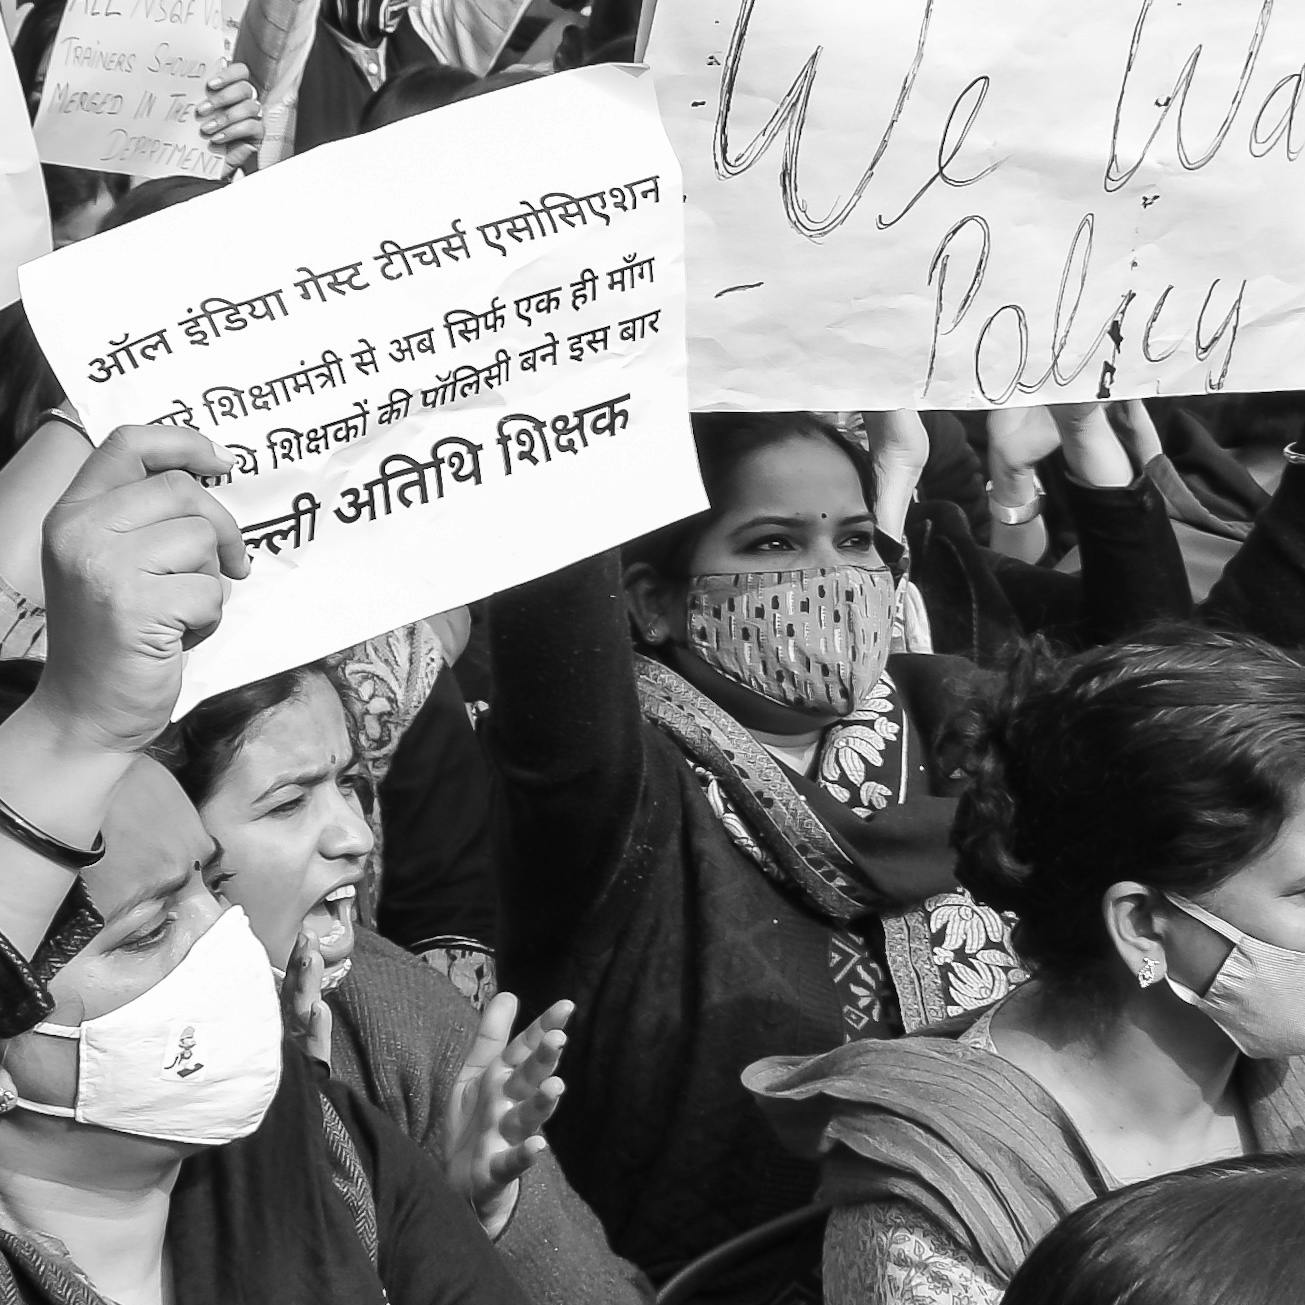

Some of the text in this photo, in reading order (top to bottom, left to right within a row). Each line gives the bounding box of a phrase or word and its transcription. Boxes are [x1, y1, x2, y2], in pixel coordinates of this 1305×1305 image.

[134, 89, 157, 120] IN
[88, 174, 661, 382] ऑल इंडिया गेस्ट टीचर्स एसोसिएशन
[202, 349, 347, 427] शिक्षामंत्री
[351, 338, 380, 376] से
[388, 327, 436, 364] अब
[444, 297, 506, 349] सिर्फ
[513, 287, 563, 327] एक
[570, 268, 599, 311] ही
[606, 252, 656, 293] माँग
[920, 212, 1248, 408] Policy
[266, 399, 370, 469] शिक्षकों
[377, 387, 414, 426] की
[420, 348, 512, 410] पॉलिसी
[519, 332, 560, 373] बने
[567, 325, 611, 362] इस
[618, 309, 662, 342] बार
[240, 393, 632, 563] ल्ली अतिथि शिक्षक
